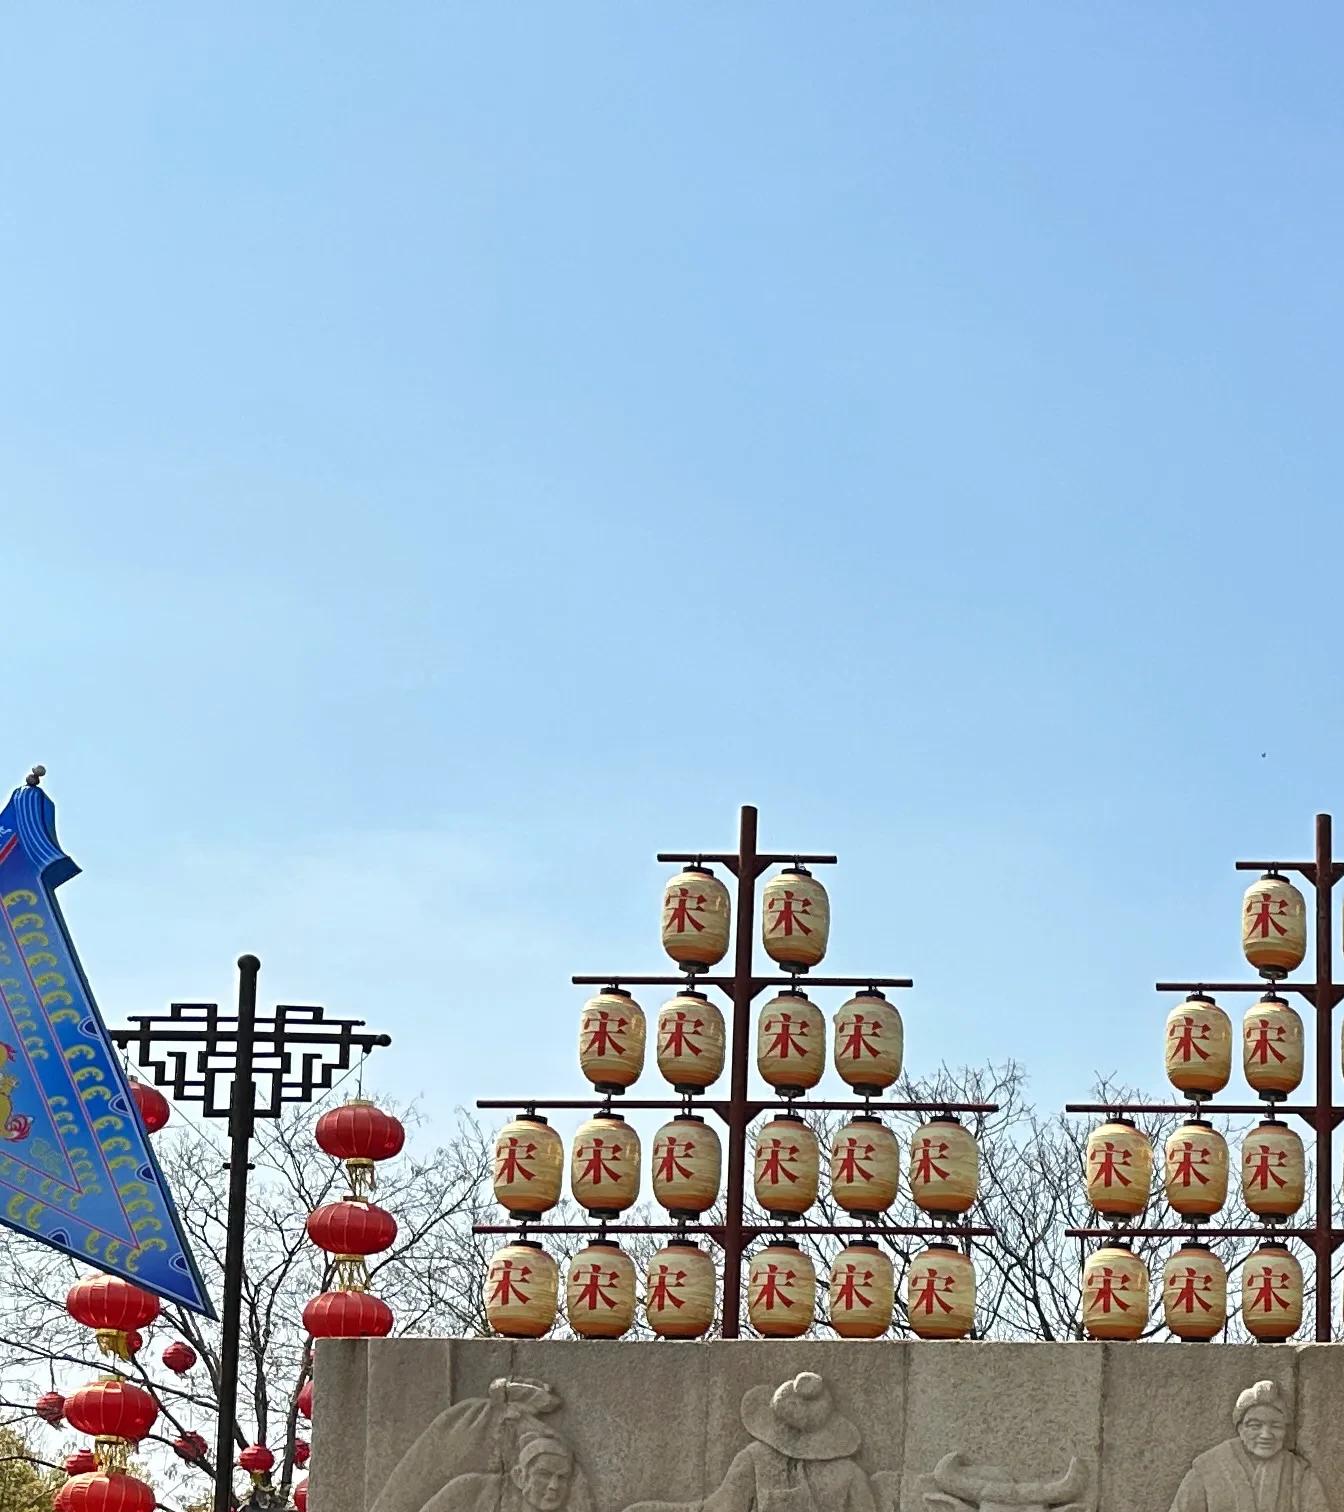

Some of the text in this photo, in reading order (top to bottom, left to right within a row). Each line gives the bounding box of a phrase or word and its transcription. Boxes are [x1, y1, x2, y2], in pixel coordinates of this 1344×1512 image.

[665, 888, 707, 934] 宋
[767, 891, 812, 937] 宋
[1245, 893, 1288, 939] 宋
[583, 1011, 629, 1057] 宋
[660, 1012, 705, 1058] 宋
[765, 1013, 810, 1059] 宋
[838, 1013, 883, 1059] 宋
[1169, 1016, 1211, 1063] 宋
[1246, 1019, 1286, 1065] 宋
[495, 1138, 538, 1185] 宋
[577, 1138, 622, 1185] 宋
[654, 1136, 696, 1184] 宋
[757, 1138, 800, 1185] 宋
[832, 1138, 875, 1184] 宋
[911, 1138, 950, 1184] 宋
[1090, 1142, 1132, 1187] 宋
[1168, 1141, 1210, 1187] 宋
[1245, 1144, 1288, 1190] 宋
[488, 1260, 532, 1305] 宋
[572, 1263, 620, 1310] 宋
[647, 1265, 687, 1310] 宋
[751, 1264, 796, 1310] 宋
[830, 1264, 874, 1310] 宋
[910, 1268, 954, 1314] 宋
[1088, 1268, 1131, 1314] 宋
[1169, 1268, 1212, 1314] 宋
[1247, 1266, 1289, 1312] 宋
